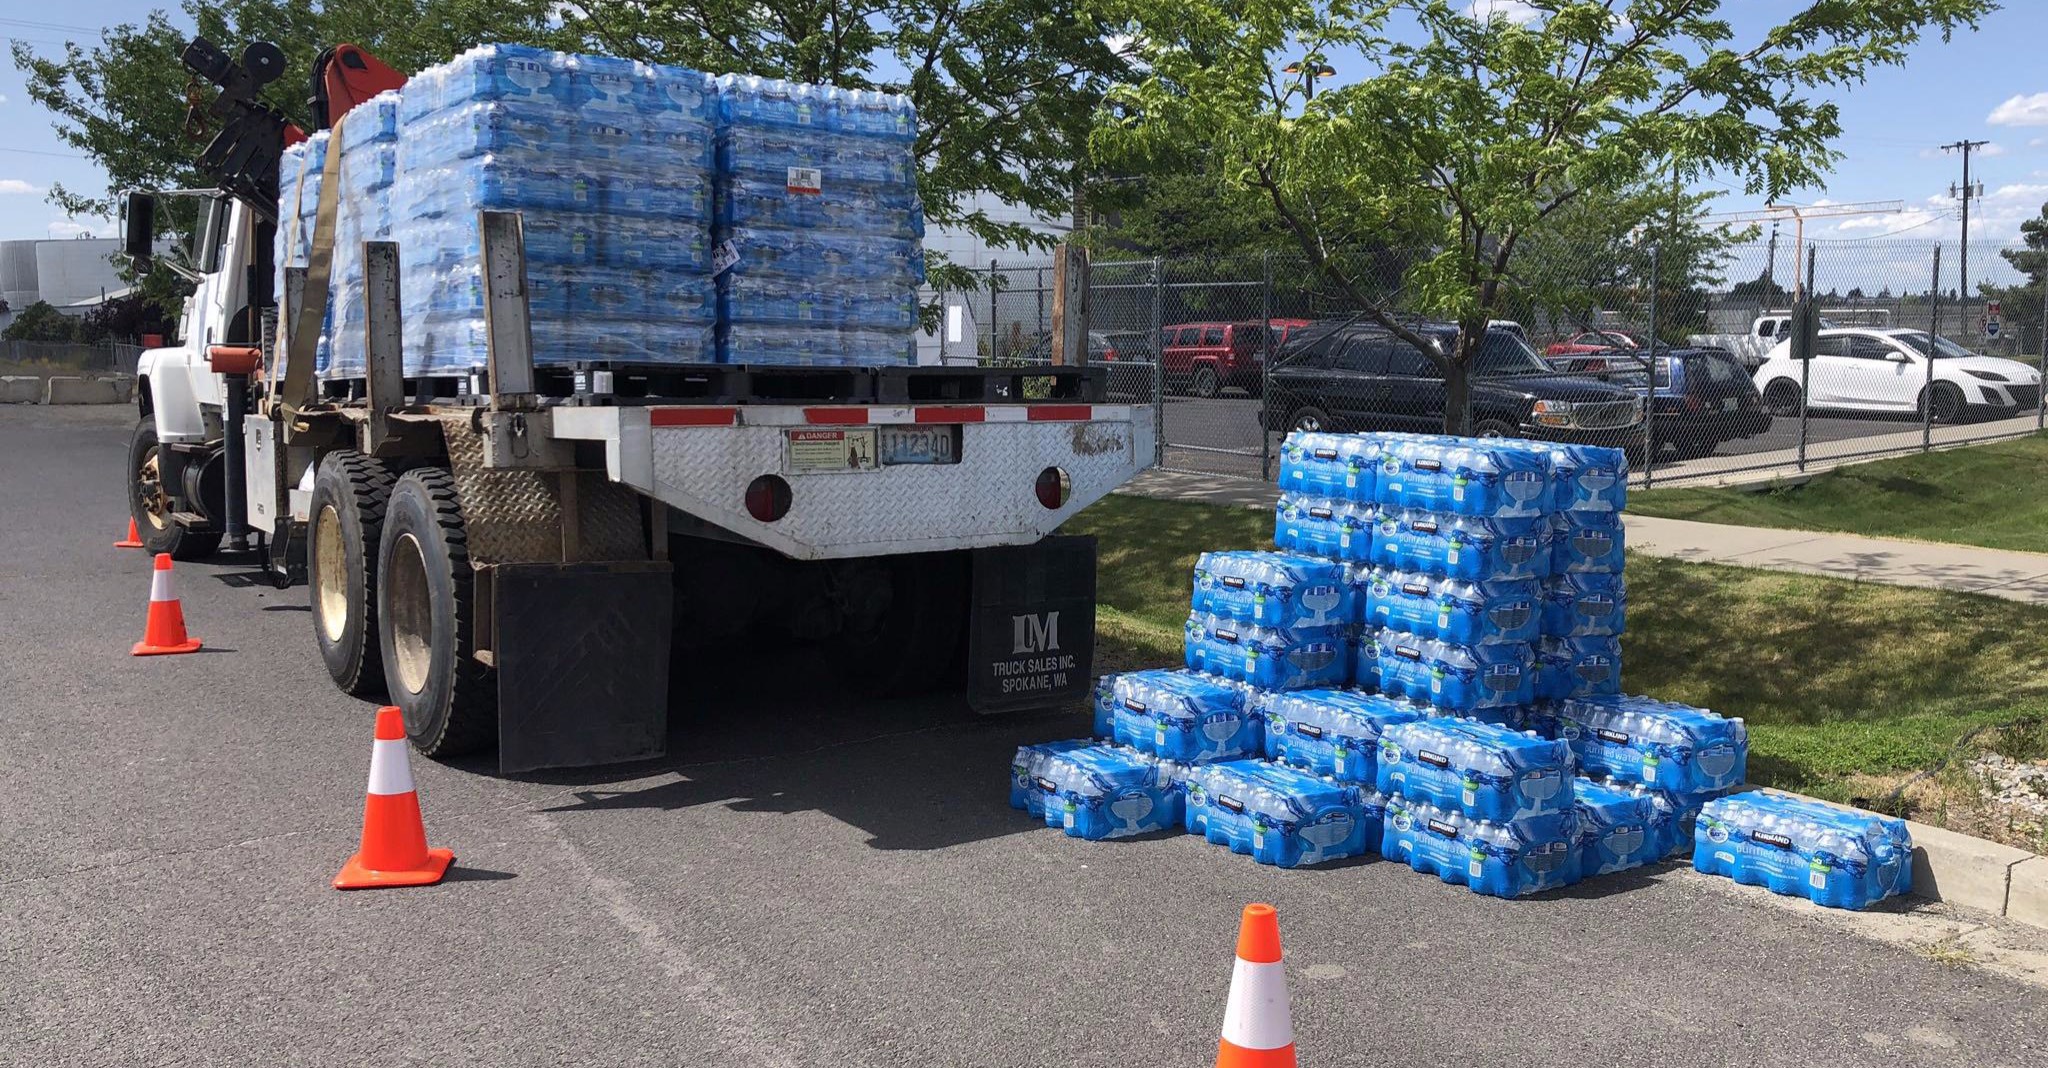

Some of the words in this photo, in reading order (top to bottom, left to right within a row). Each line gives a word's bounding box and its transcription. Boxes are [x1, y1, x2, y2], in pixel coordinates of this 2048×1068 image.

[993, 660, 1025, 676] TRUCK
[1028, 657, 1057, 673] SALES
[1059, 655, 1076, 669] INC.
[1002, 674, 1052, 693] SPOKANE,
[1053, 672, 1068, 687] WA
[1599, 729, 1628, 741] KIRKLAND
[1754, 831, 1790, 845] KIRKLAND
